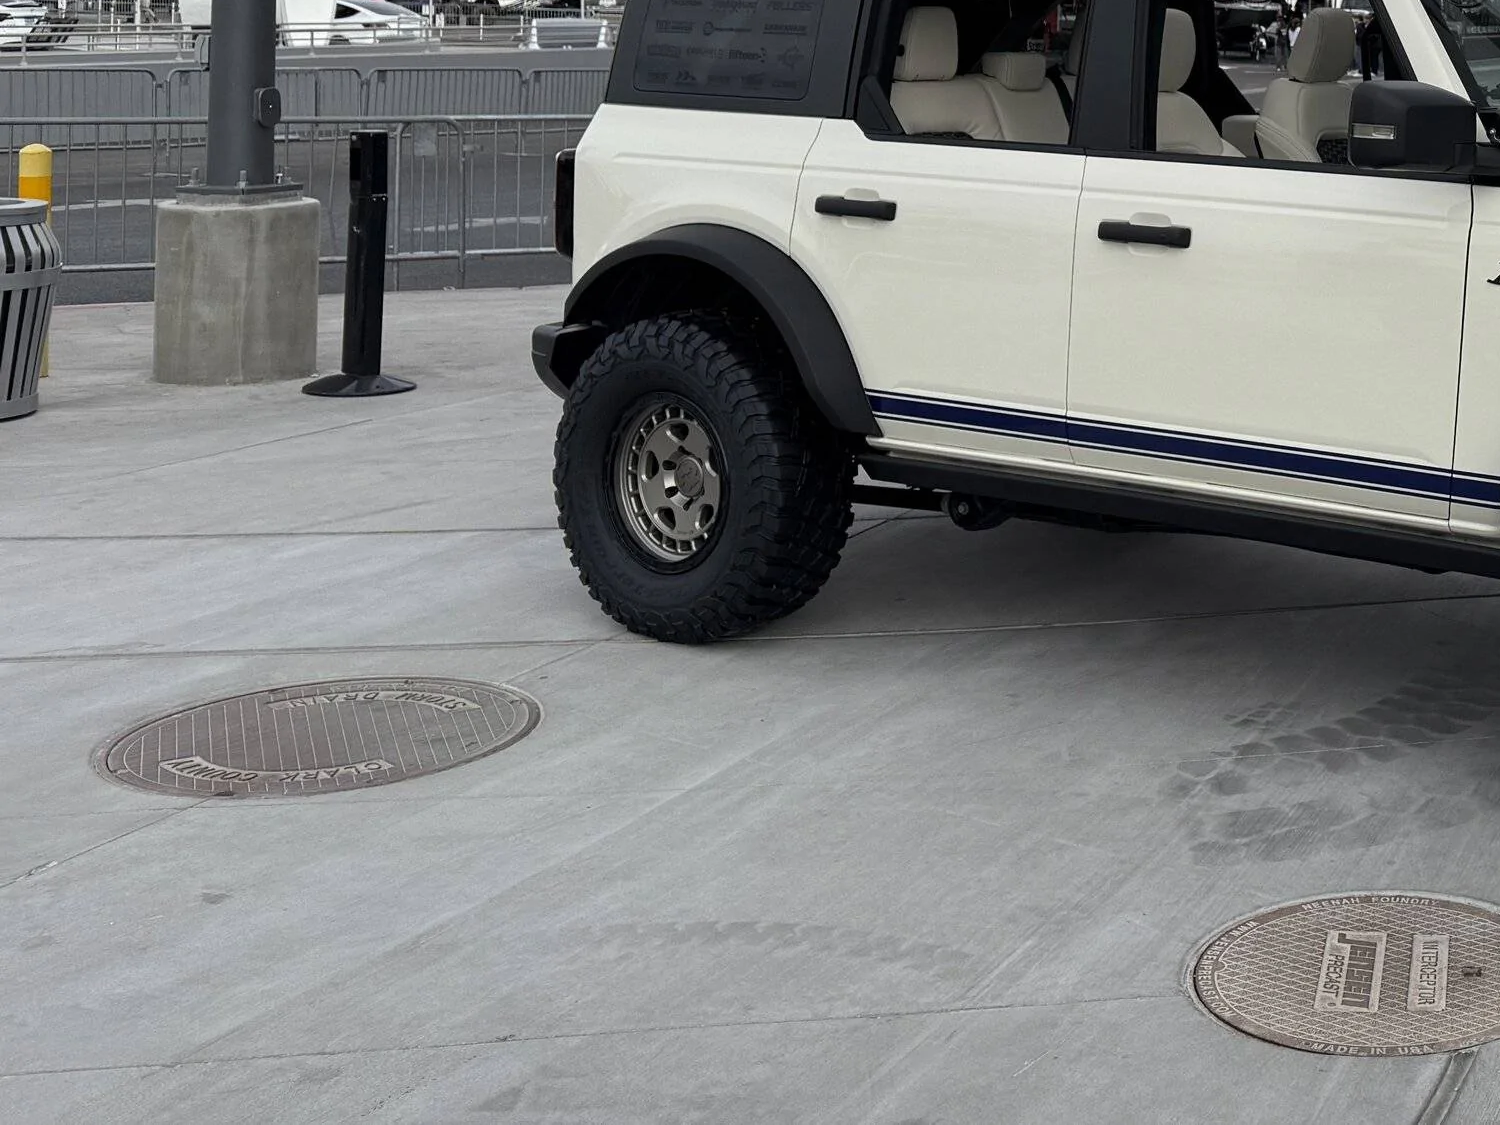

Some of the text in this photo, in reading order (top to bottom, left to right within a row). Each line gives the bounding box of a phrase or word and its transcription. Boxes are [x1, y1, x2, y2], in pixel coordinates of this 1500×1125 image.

[166, 759, 383, 783] CLARK COUNTY
[1302, 896, 1441, 912] NEENAH FOUNDRY
[1323, 953, 1344, 997] PRECAST
[1337, 933, 1379, 1009] JENSEN
[1417, 941, 1440, 1006] INTERCEPTOR
[1307, 1042, 1435, 1056] MADE IN USA
